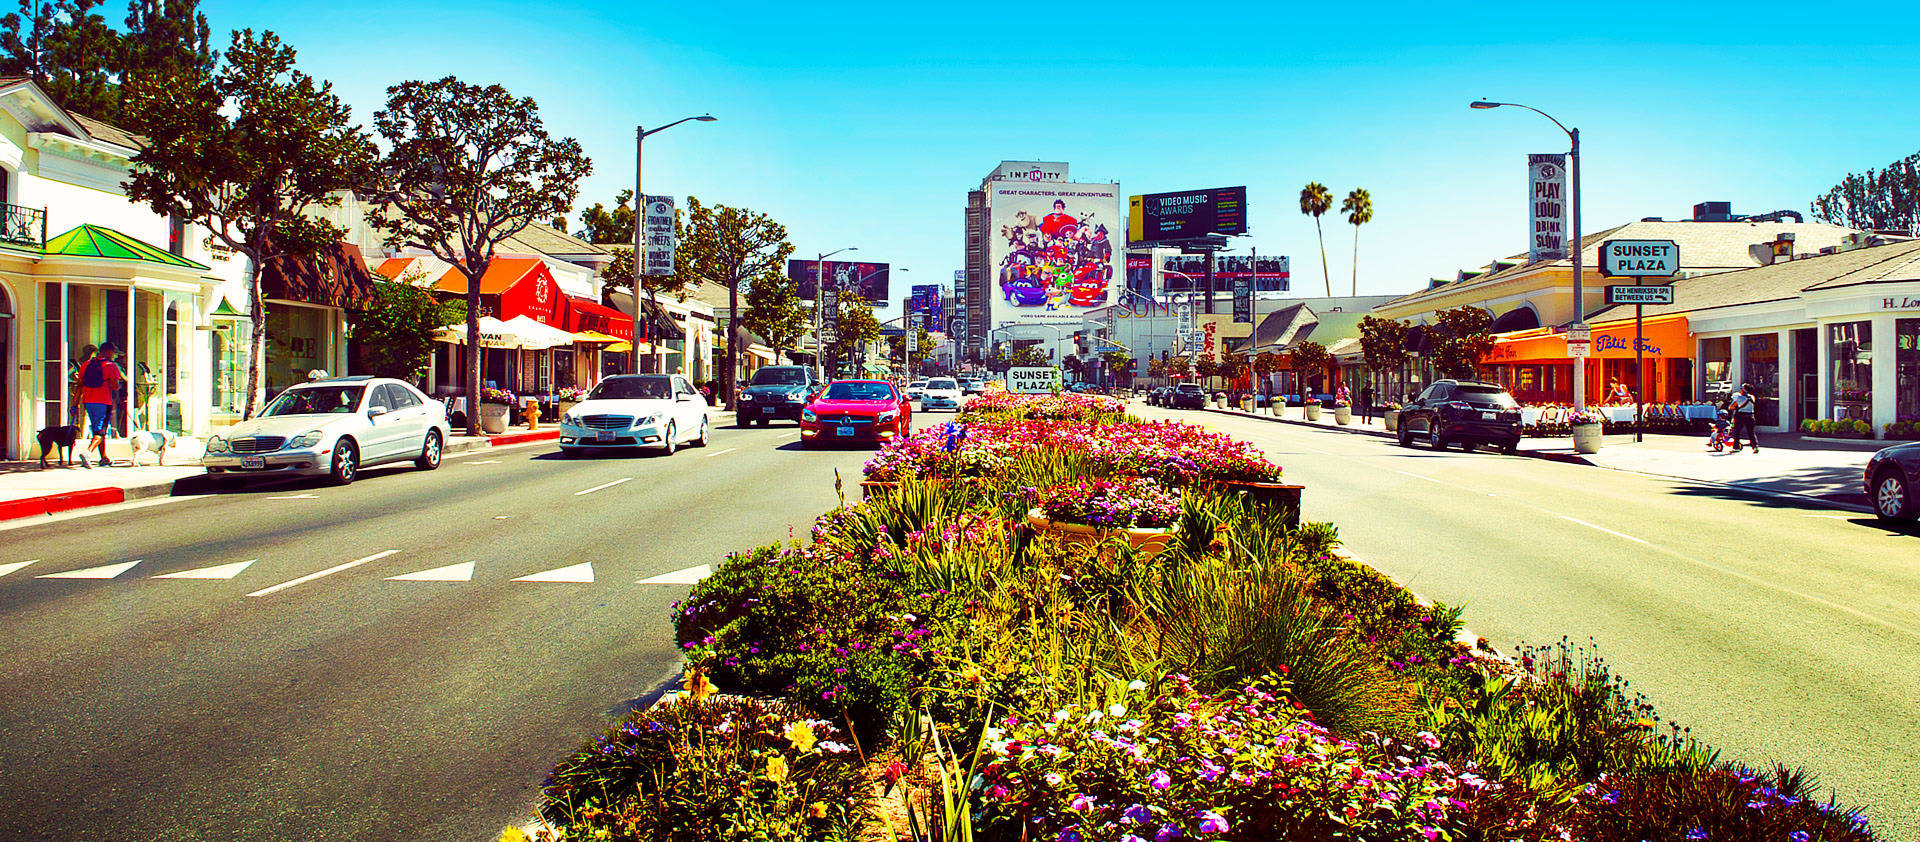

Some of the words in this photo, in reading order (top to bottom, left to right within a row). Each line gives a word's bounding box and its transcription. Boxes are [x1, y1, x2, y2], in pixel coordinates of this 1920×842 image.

[1010, 170, 1060, 181] INFINITY
[1535, 181, 1560, 199] PLAY
[1160, 197, 1181, 207] VIDEO
[1183, 194, 1208, 205] MUSIC
[1160, 205, 1193, 216] AWARDS
[1535, 201, 1560, 219] LOUD
[1535, 220, 1561, 233] DRINK
[1535, 234, 1561, 250] SLOW
[1613, 245, 1669, 257] SUNSET
[1618, 260, 1666, 271] PLAZA
[1882, 297, 1898, 309] H.
[1596, 334, 1627, 352] Petit
[1012, 370, 1056, 380] SUNSET
[1016, 381, 1053, 390] PLAZA
